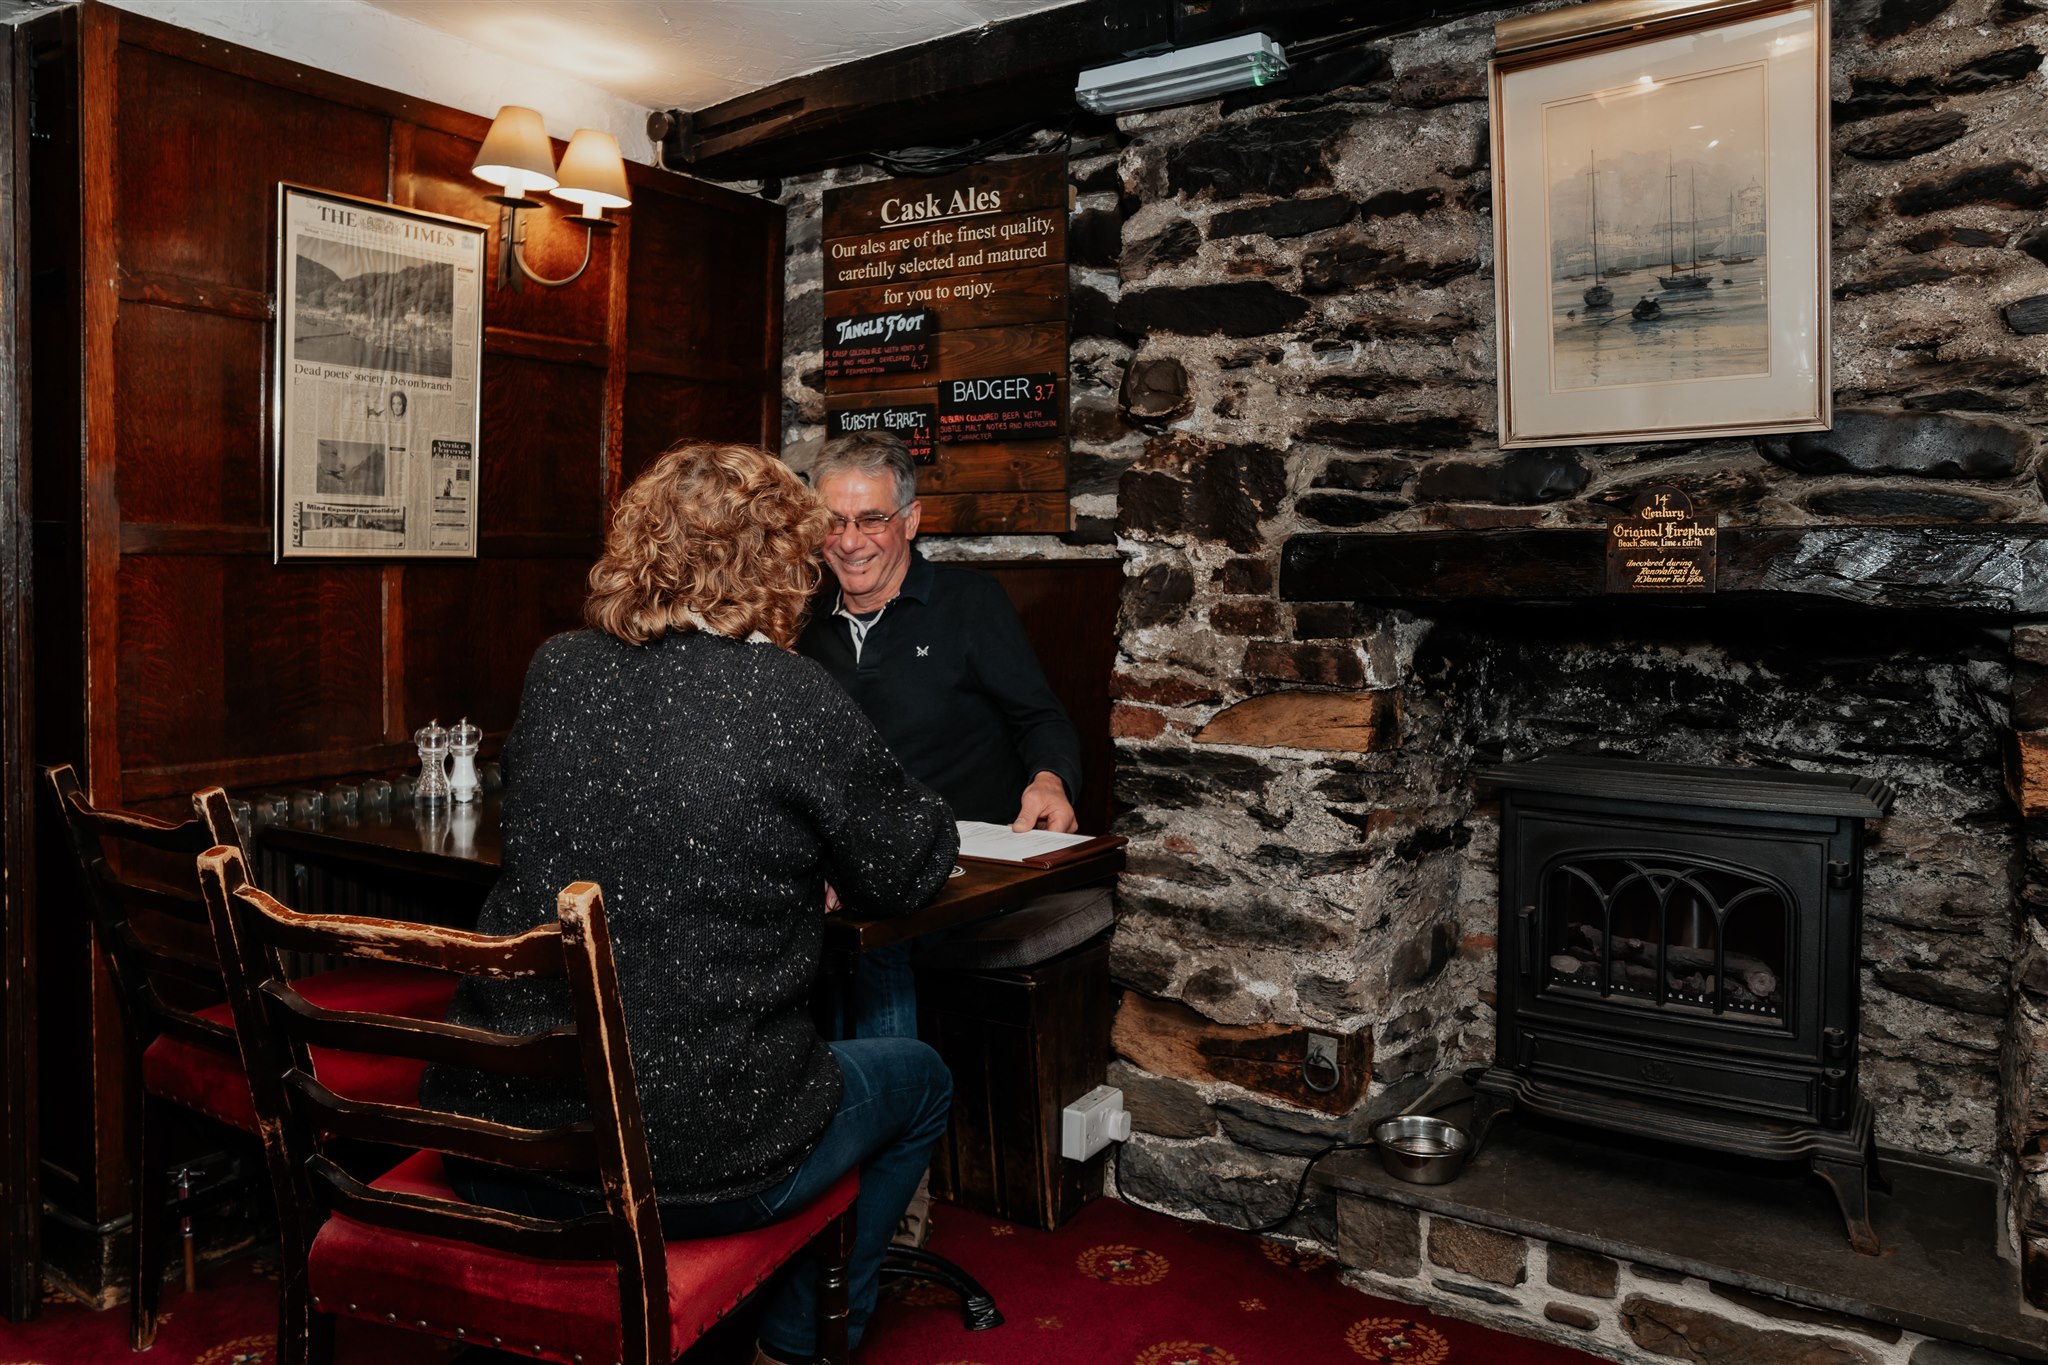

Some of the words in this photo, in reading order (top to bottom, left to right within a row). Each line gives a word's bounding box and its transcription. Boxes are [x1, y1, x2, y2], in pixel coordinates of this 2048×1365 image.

[880, 194, 942, 224] Cask
[946, 187, 1001, 215] Ales
[317, 206, 357, 227] THE
[402, 223, 454, 247] TIMES
[831, 244, 857, 260] Our
[860, 239, 885, 256] ales
[889, 236, 910, 252] are
[913, 231, 930, 248] of
[932, 229, 953, 246] the
[957, 223, 997, 243] finest
[1000, 216, 1055, 240] quality,
[838, 263, 896, 282] carefully
[899, 254, 954, 275] selected
[957, 248, 983, 267] and
[987, 241, 1047, 263] matured
[883, 289, 903, 305] for
[906, 288, 932, 307] you
[935, 284, 950, 299] to
[953, 279, 996, 299] enjoy.
[836, 317, 884, 345] TANGLE
[884, 313, 925, 342] FOOT
[910, 354, 929, 370] 4.7
[294, 364, 321, 376] Dead
[324, 370, 352, 380] poets'
[390, 375, 419, 388] Devon
[421, 379, 452, 391] branch
[953, 378, 1030, 402] BADGER
[1034, 383, 1055, 401] 3.7
[840, 412, 880, 430] FURSTY
[883, 409, 927, 430] FERRET
[940, 415, 965, 424] AUBURN
[965, 412, 999, 422] COLOURED
[1002, 411, 1020, 420] BEER
[1023, 410, 1042, 419] WITH
[913, 427, 931, 440] 4.1
[940, 424, 962, 433] SUBTLE
[965, 423, 981, 431] MALT
[985, 422, 1008, 431] NOTES
[1009, 421, 1022, 429] AND
[433, 446, 470, 455] Florence
[438, 441, 466, 449] Venice
[306, 503, 326, 511] Mind
[327, 506, 370, 514] Expanding
[371, 507, 400, 515] Holidays
[1641, 506, 1685, 520] Century
[1613, 523, 1663, 540] Original
[1665, 522, 1716, 539] Fireplace
[1661, 538, 1676, 547] Lime
[1626, 558, 1666, 567] Uncovered
[1666, 558, 1693, 568] during
[1639, 566, 1688, 575] Renovations
[1689, 566, 1701, 577] by
[1672, 575, 1686, 583] Feb
